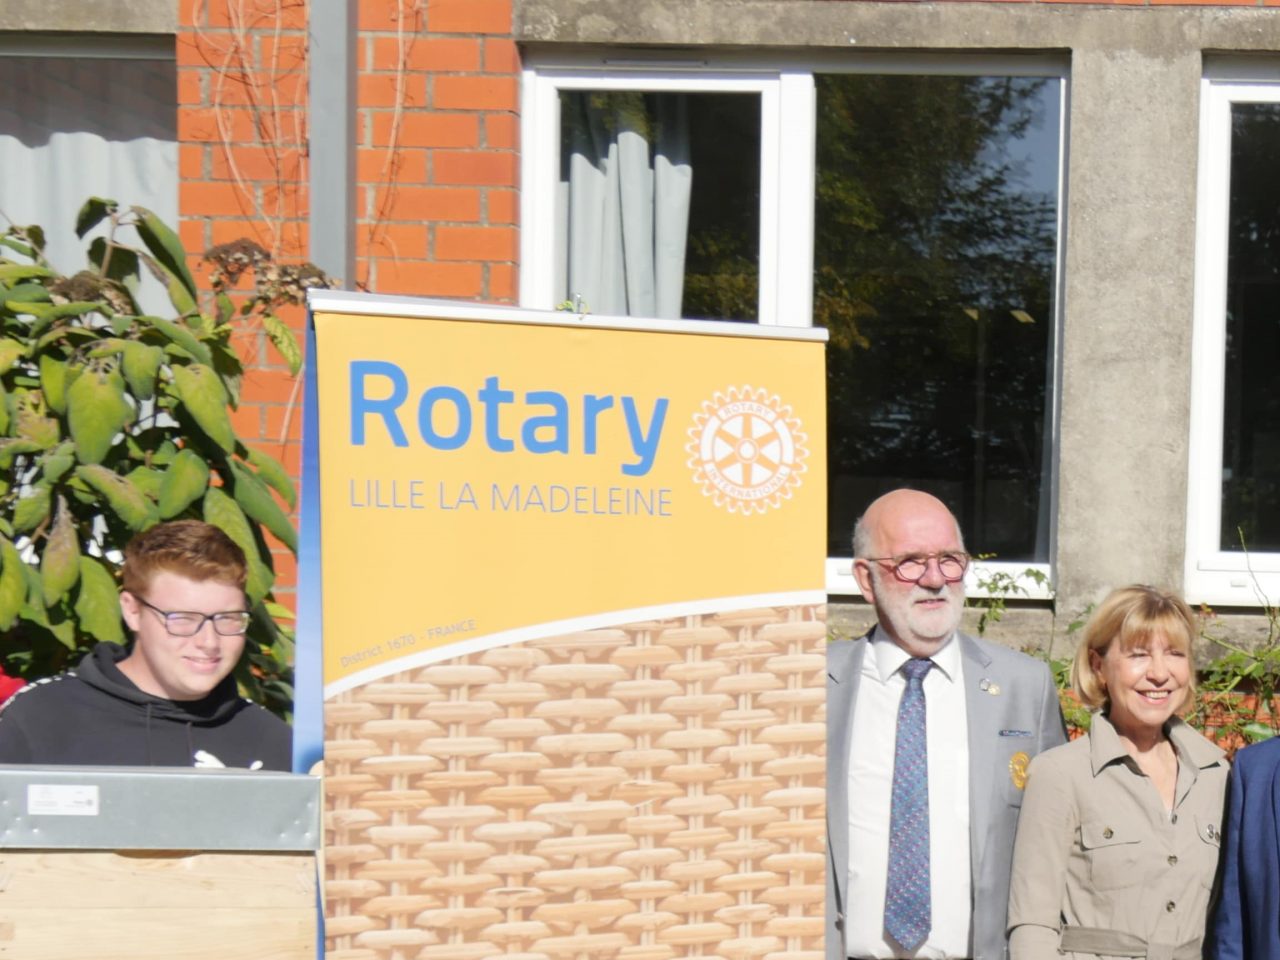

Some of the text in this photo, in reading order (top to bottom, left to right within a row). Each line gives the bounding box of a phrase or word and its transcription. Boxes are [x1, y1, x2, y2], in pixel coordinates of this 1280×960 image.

[349, 359, 669, 477] Rotary
[723, 402, 774, 419] ROTARY
[350, 479, 673, 517] LILLE LA MADELEINE
[708, 467, 789, 499] INTERNATIONAL
[339, 645, 383, 668] District
[387, 633, 416, 651] 1670
[427, 618, 477, 640] FRANCE
